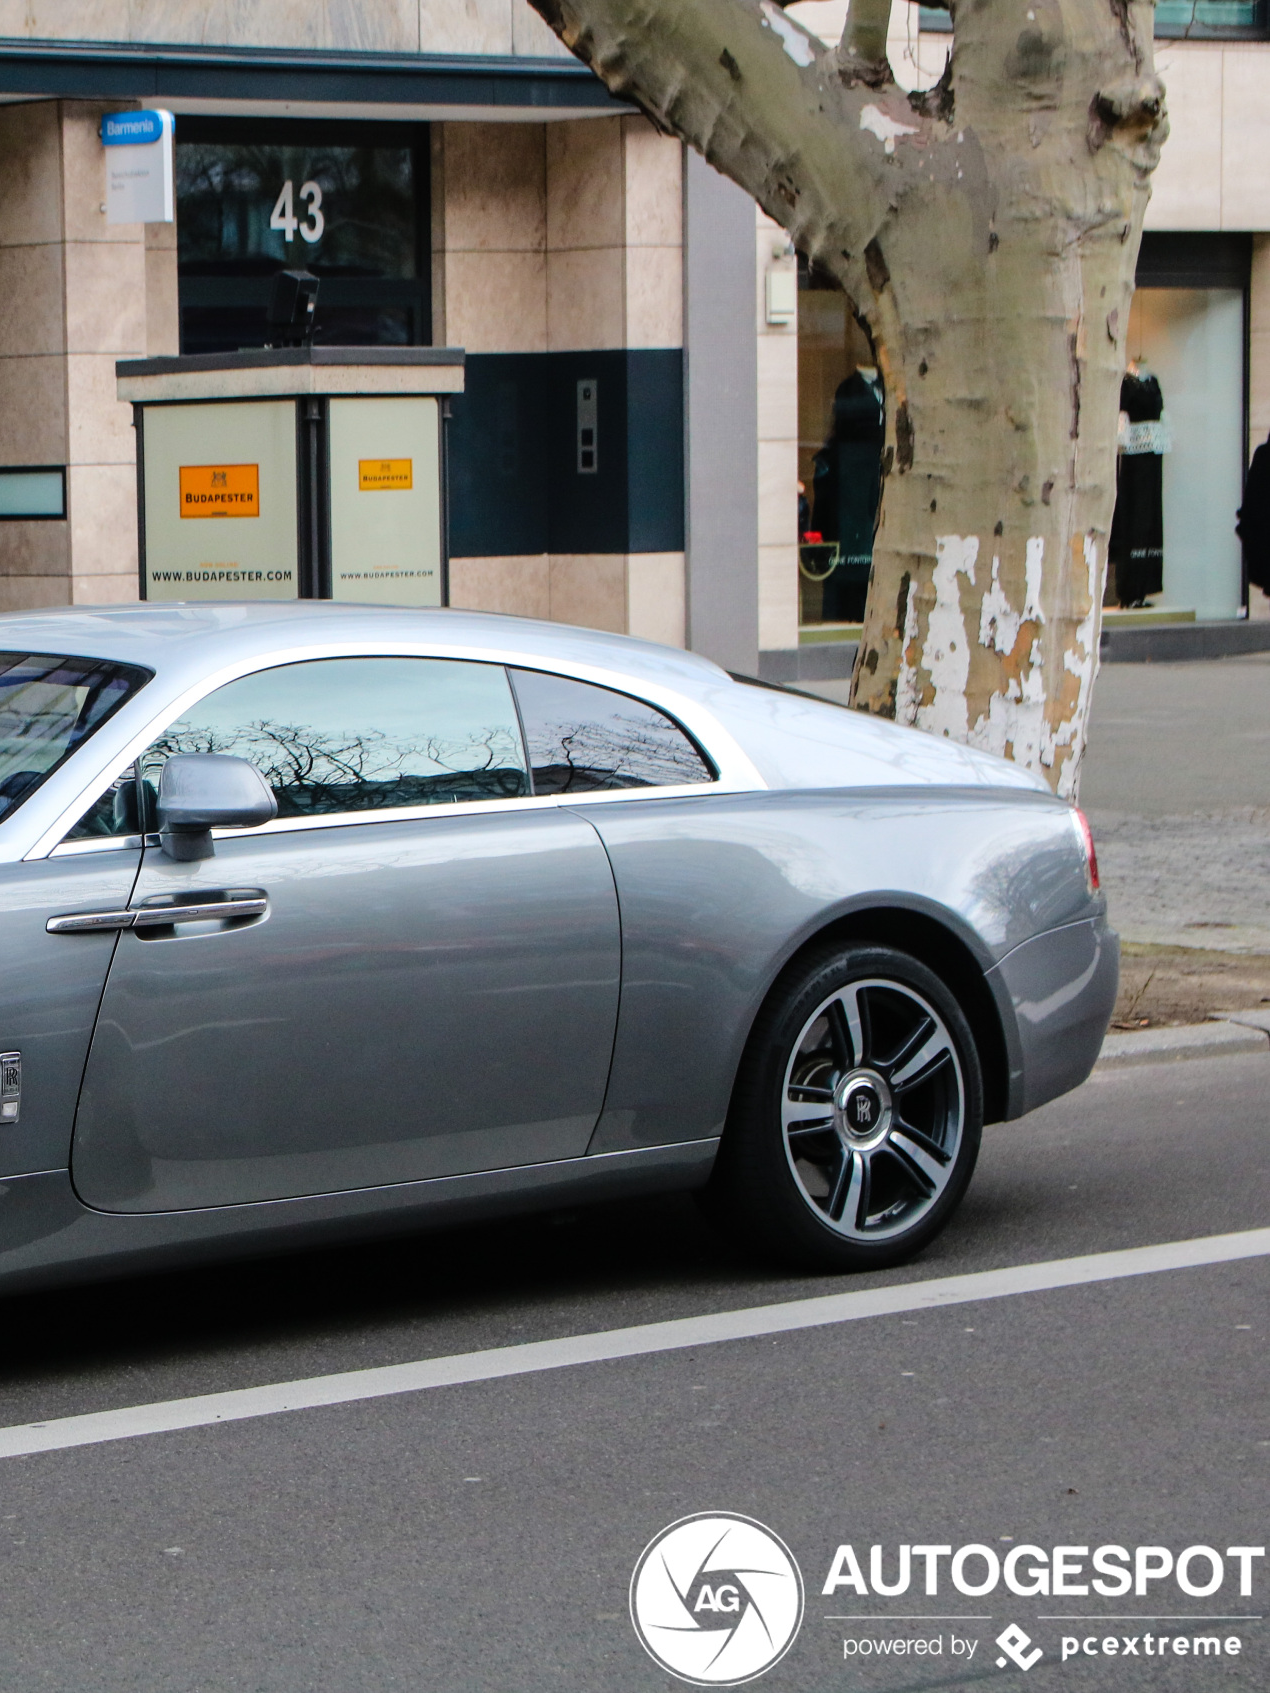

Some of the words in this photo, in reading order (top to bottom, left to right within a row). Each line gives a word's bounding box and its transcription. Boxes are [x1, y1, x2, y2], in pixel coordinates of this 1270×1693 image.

[106, 119, 154, 136] Barmenia
[270, 179, 325, 243] 43
[185, 493, 253, 503] BUDAPESTER
[152, 571, 292, 581] WWW.BUDAPESTER.COM
